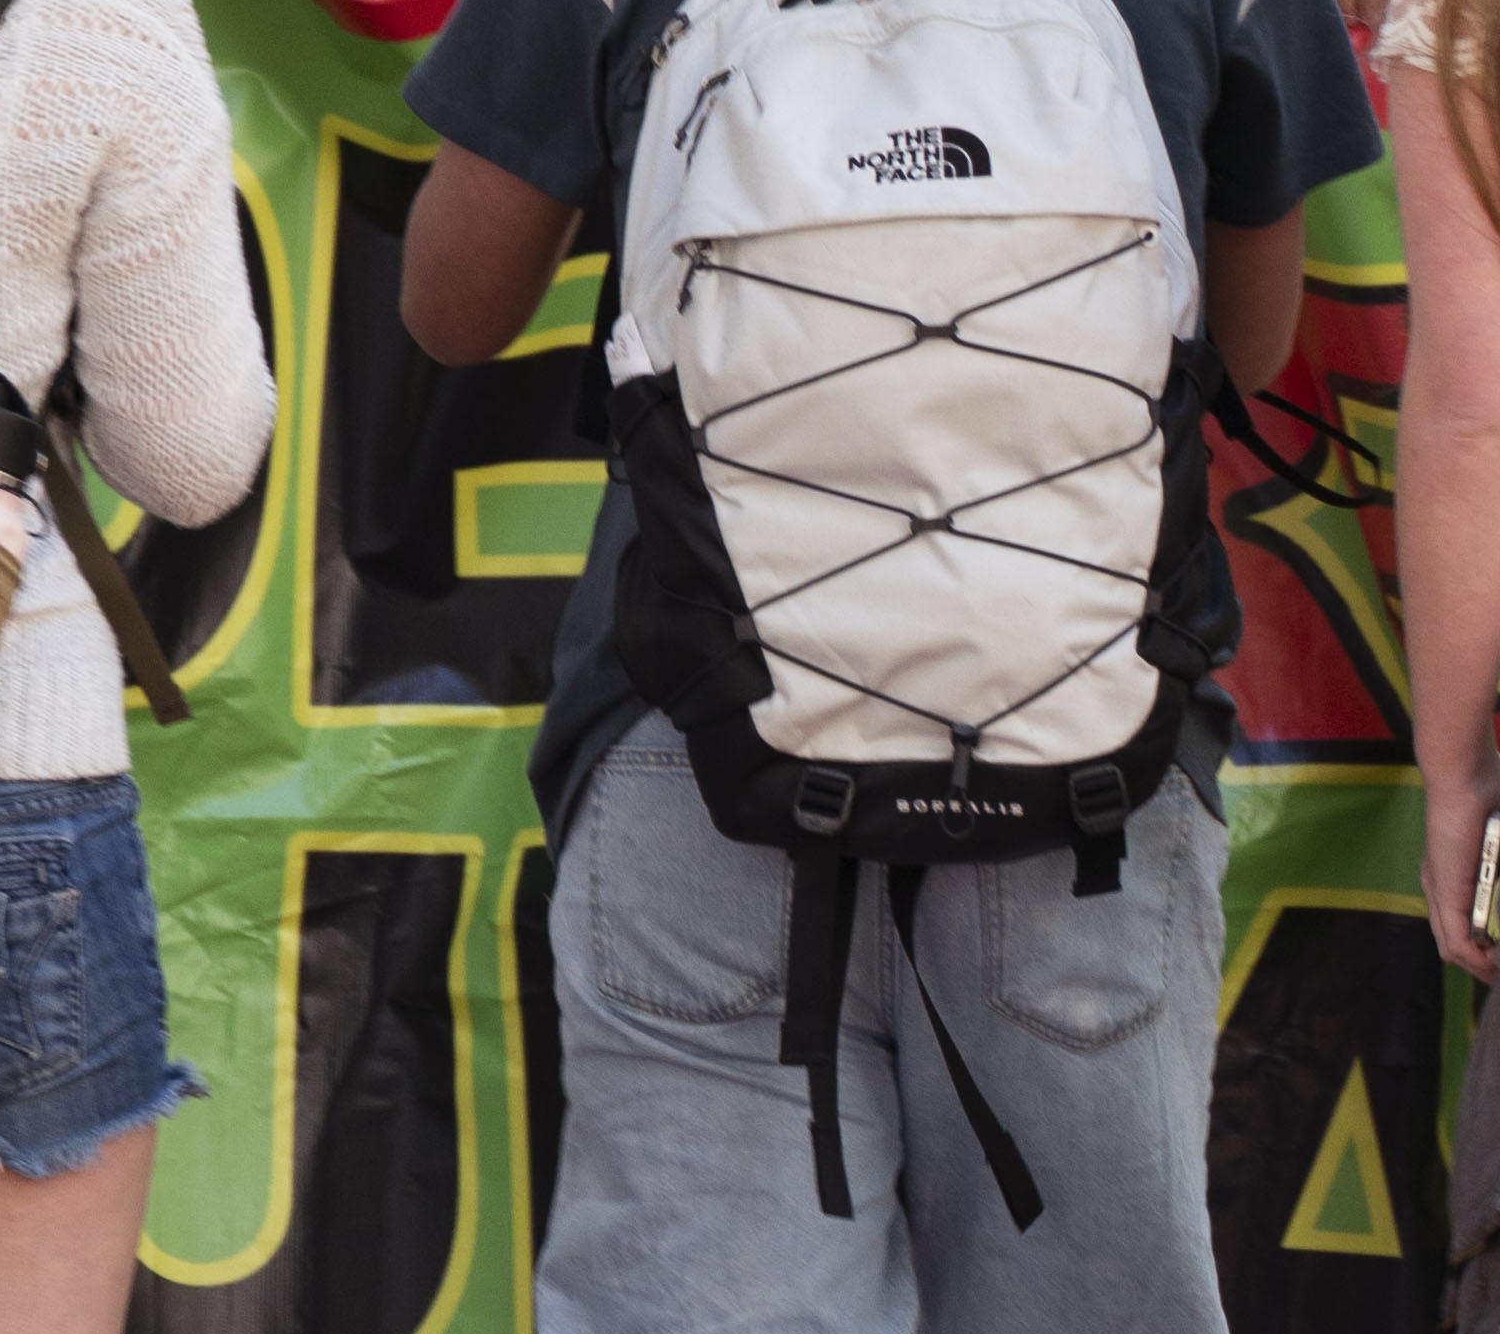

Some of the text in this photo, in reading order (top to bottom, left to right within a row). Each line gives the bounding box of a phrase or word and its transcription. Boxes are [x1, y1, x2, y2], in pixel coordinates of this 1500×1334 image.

[887, 126, 940, 148] THE
[847, 147, 941, 171] NORTH
[875, 163, 942, 184] FACE
